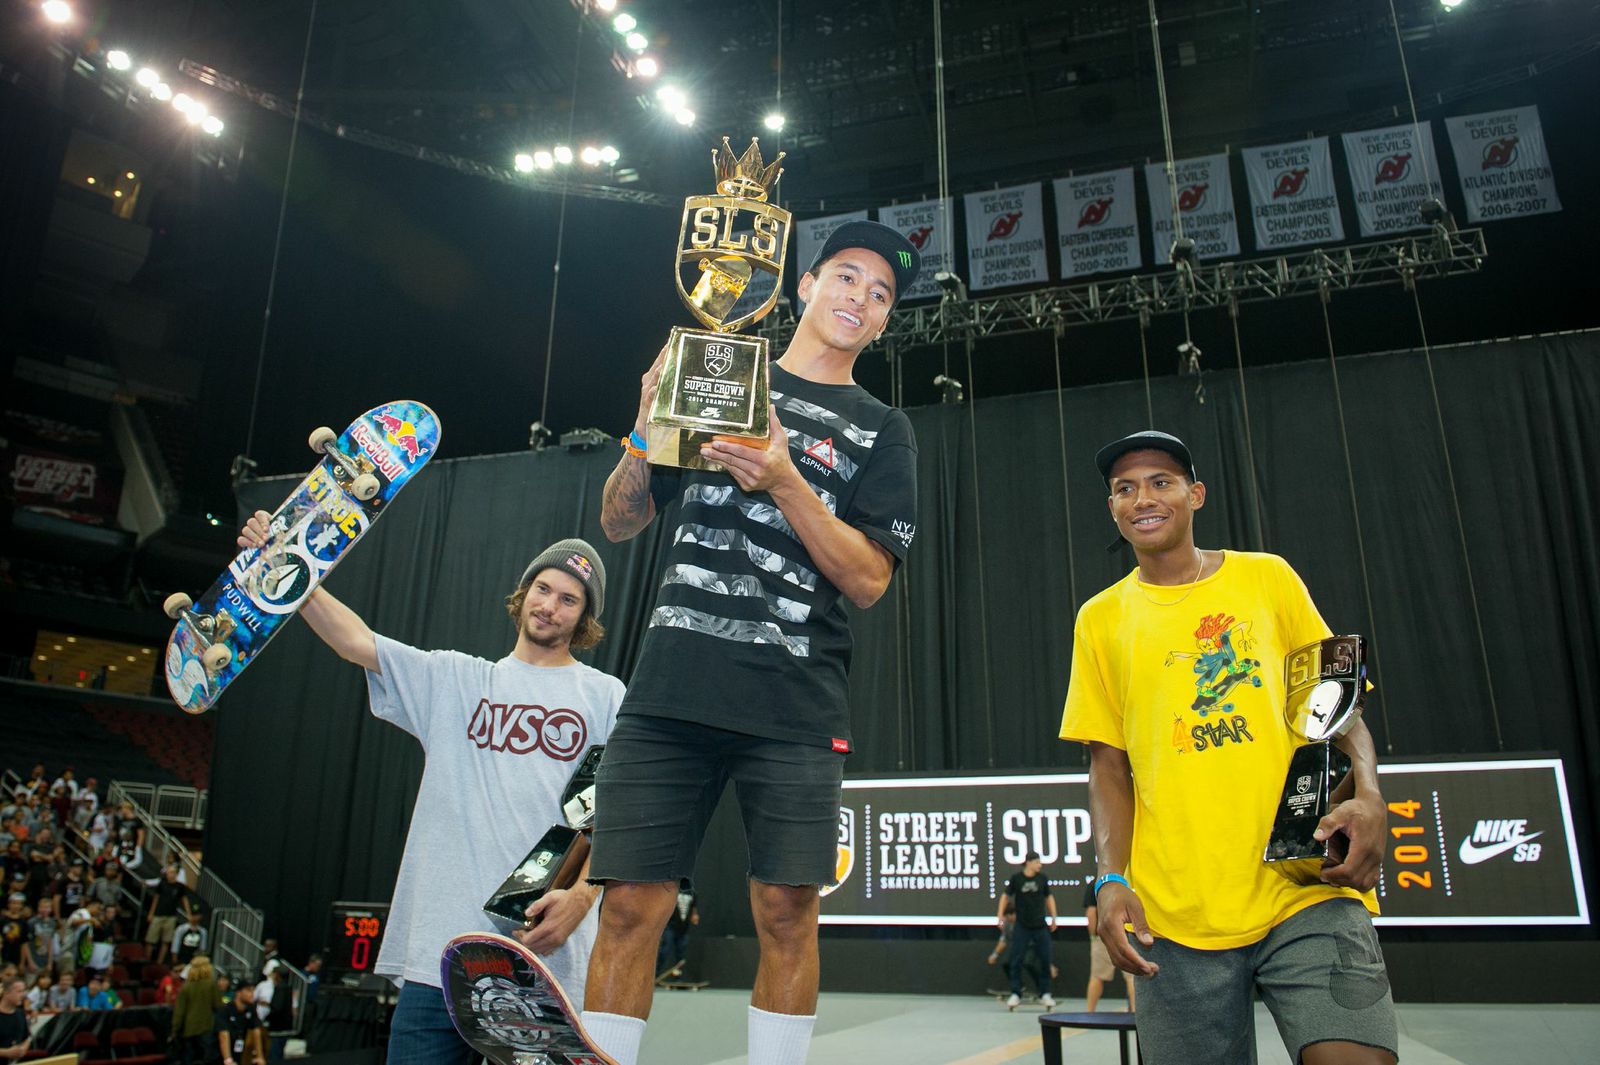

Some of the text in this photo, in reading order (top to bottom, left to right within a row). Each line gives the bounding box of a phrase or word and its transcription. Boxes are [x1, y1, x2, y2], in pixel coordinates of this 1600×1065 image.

[1486, 115, 1518, 126] JERSEY
[1382, 129, 1413, 141] JERSEY
[1471, 124, 1518, 140] DEVILS
[1367, 137, 1411, 155] DEVILS
[1266, 154, 1310, 169] DEVILS
[1464, 167, 1551, 190] ATLANTIC DIVISION
[1074, 185, 1114, 200] DEVILS
[1358, 187, 1400, 203] ATLANTIC
[1483, 184, 1538, 203] CHAMPIONS
[984, 200, 1023, 214] DEVILS
[1256, 196, 1336, 218] EASTERN CONFERENCE
[1480, 199, 1548, 218] 2006-2007
[897, 213, 934, 228] DEVILS
[1155, 211, 1234, 231] ATLATIC DIVISION
[1267, 212, 1329, 232] CHAMPIONS
[691, 206, 778, 259] SLS
[1061, 225, 1135, 247] EASTERN CONFERENCE
[1269, 228, 1331, 245] 2002-2003
[971, 239, 1043, 260] ATLANTIC DIVISION
[1071, 242, 1128, 260] CHAMPIONS
[984, 255, 1031, 272] CHAMPIONS
[1073, 256, 1129, 273] 2000-2001
[982, 269, 1036, 286] 2000-2001
[707, 345, 732, 359] SLS
[684, 380, 712, 393] SUPER
[714, 383, 746, 397] CROWN
[800, 456, 832, 477] ASPHALT
[222, 583, 262, 632] PUDWILL
[1291, 642, 1354, 687] SLS
[467, 698, 546, 755] DVS
[879, 811, 978, 843] STREET
[1002, 808, 1097, 865] SUP
[1472, 819, 1528, 843] NIKE
[1387, 800, 1433, 889] 2014
[1513, 843, 1542, 862] SB
[879, 843, 980, 875] LEAGUE
[880, 876, 980, 890] SKATEBOARDING
[344, 917, 379, 938] 5:00
[351, 937, 370, 970] 0
